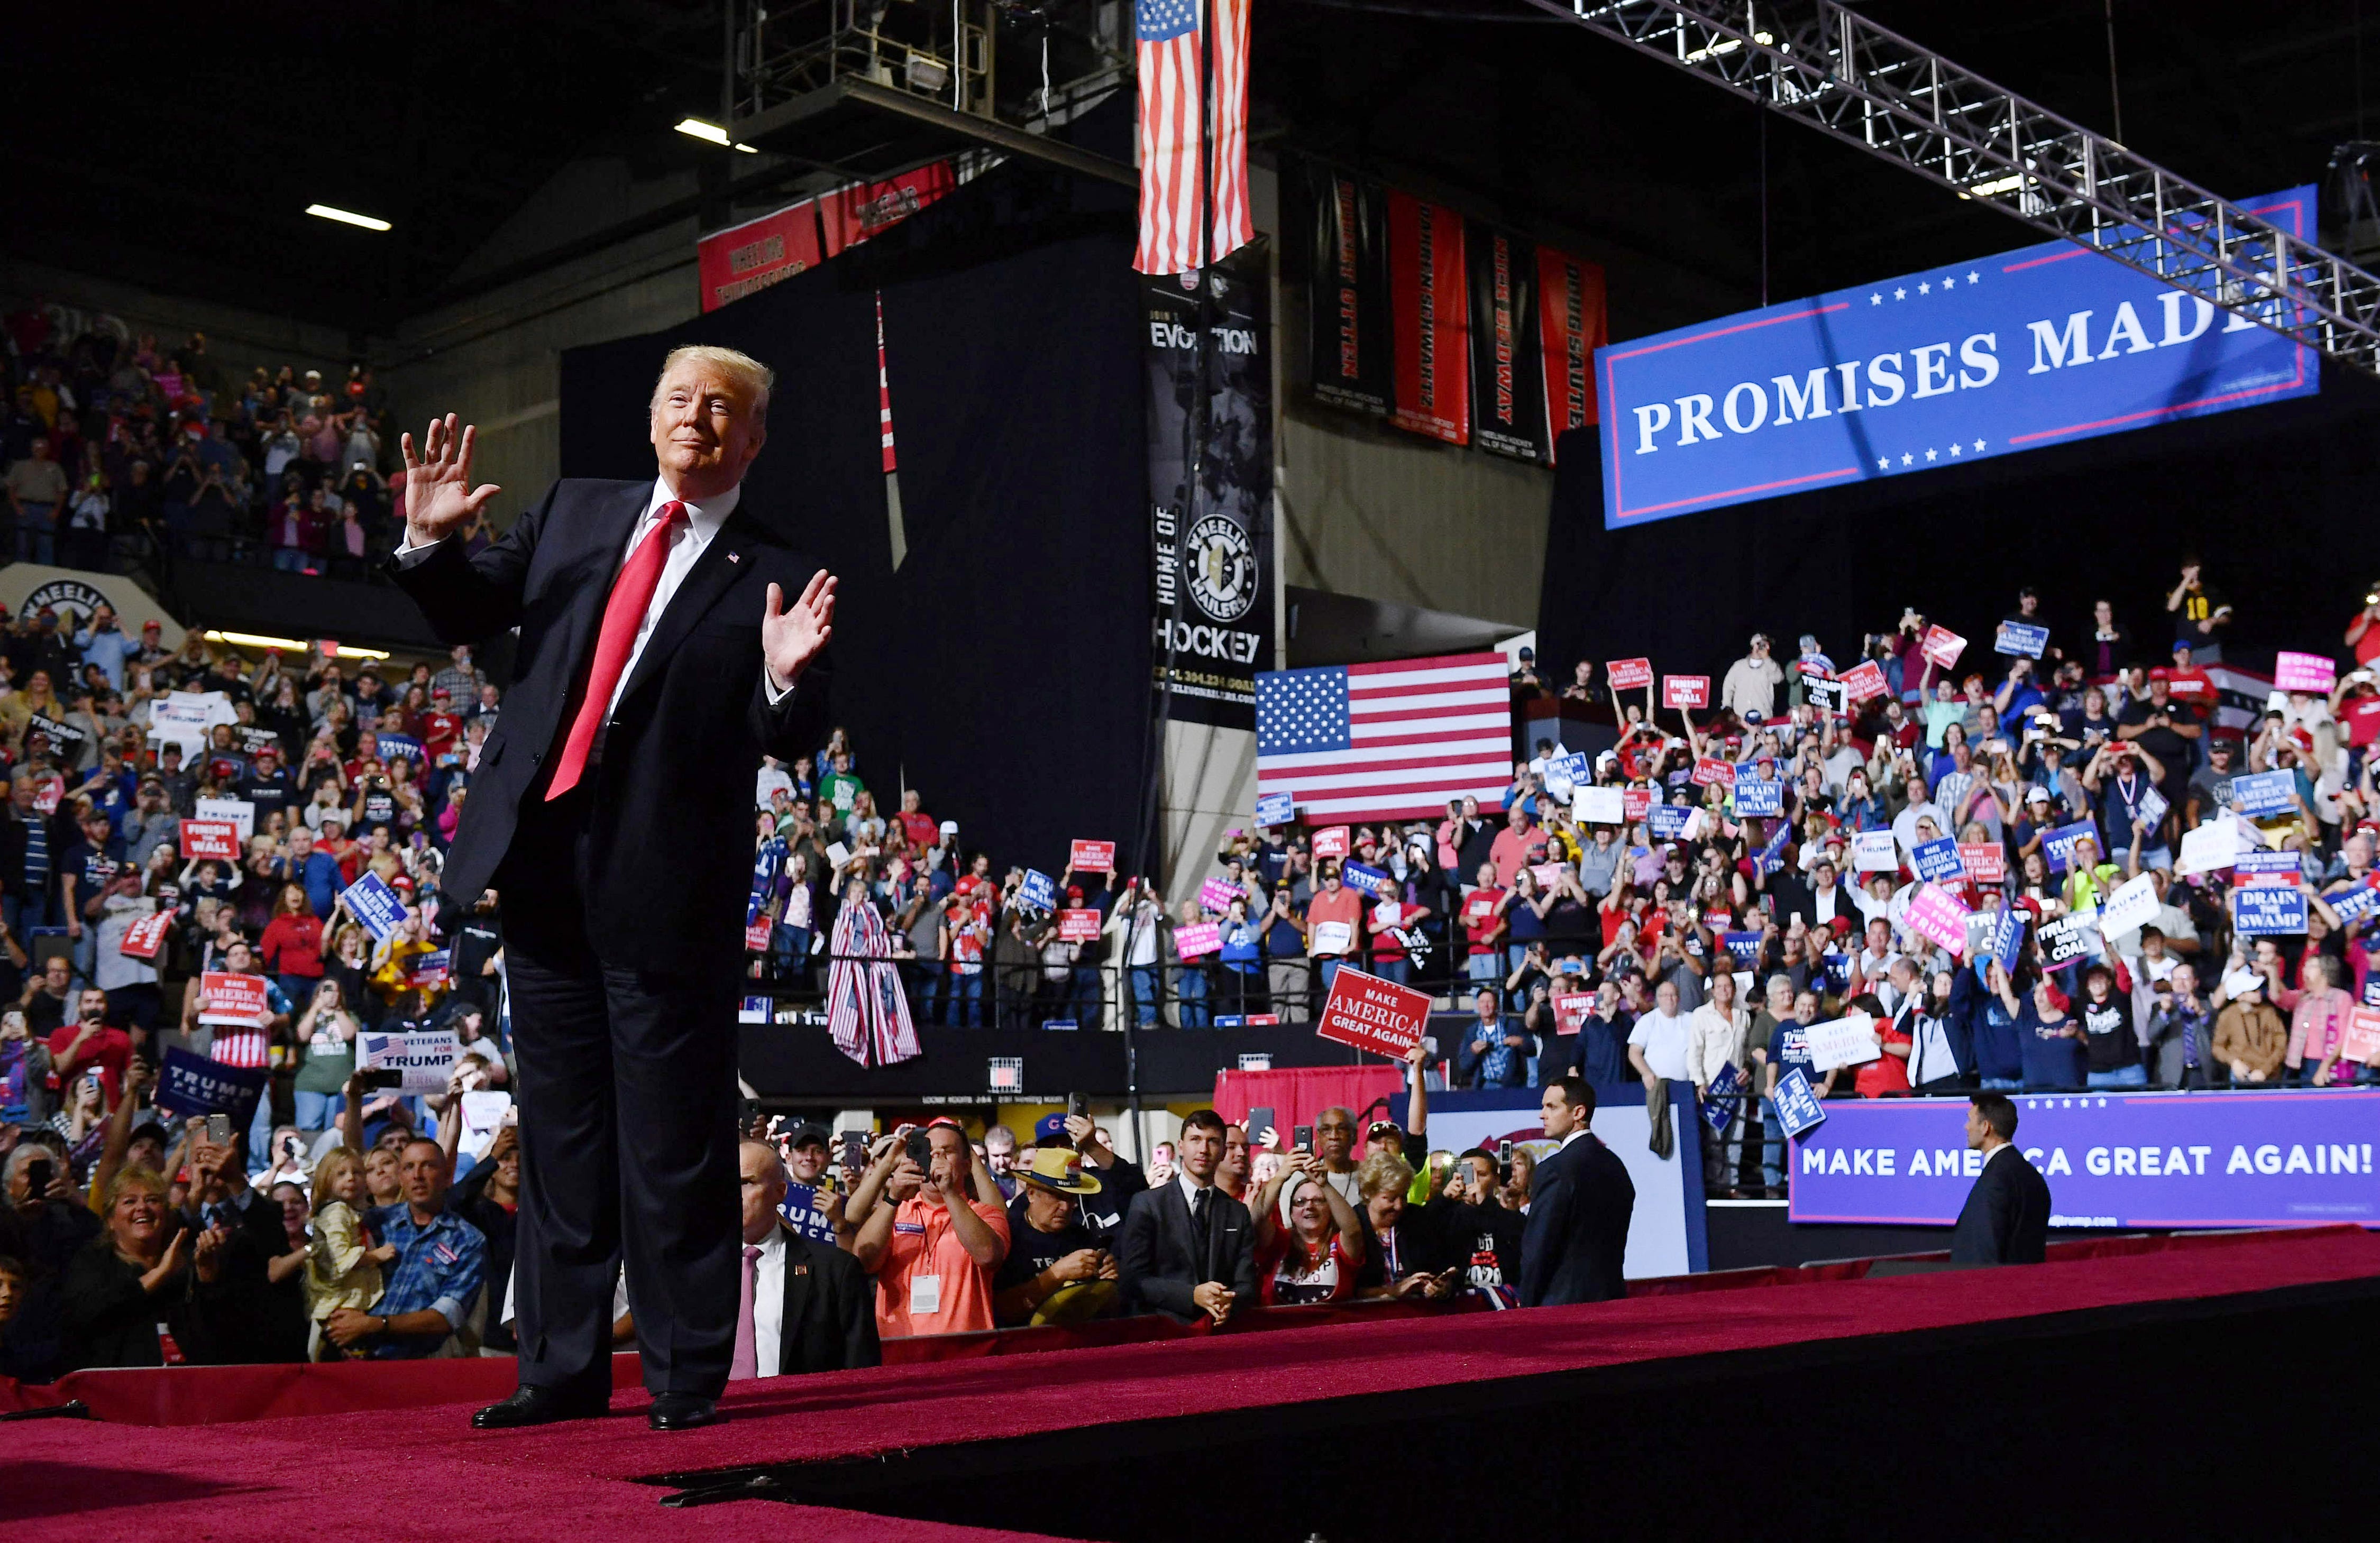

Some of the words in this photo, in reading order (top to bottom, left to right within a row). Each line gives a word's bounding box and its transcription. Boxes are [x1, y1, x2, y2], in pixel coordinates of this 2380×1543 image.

[1151, 322, 1258, 354] EVOTION
[1567, 335, 1585, 430] SAUTE
[1633, 331, 2000, 455] PROMISES
[1157, 506, 1175, 536] OF
[1188, 519, 1255, 571] WHEELING
[1157, 542, 1175, 605] HOME
[25, 584, 104, 619] WHEELI
[1191, 580, 1248, 617] MAILERS
[1158, 619, 1260, 664] HOCKEY
[2280, 655, 2335, 669] WOMEN
[1670, 679, 1703, 688] FINISH
[1802, 675, 1841, 692] TRUMP
[2280, 676, 2331, 687] TRUMP
[1671, 693, 1701, 704] WALL
[1809, 694, 1832, 708] COAL
[32, 715, 83, 740] TRUMP
[243, 742, 258, 754] CO
[1548, 757, 1581, 772] DRAIN
[1739, 786, 1775, 795] DRAIN
[1737, 801, 1778, 811] SWAMP
[1650, 815, 1685, 824] AMERIC
[188, 823, 231, 835] FINISH
[1314, 830, 1343, 842] FINISH
[190, 841, 230, 853] WALL
[1316, 842, 1342, 854] WALL
[1924, 844, 1940, 855] MAKE
[1917, 850, 1960, 869] AMERICA
[1962, 857, 2000, 866] ERICA
[1347, 867, 1381, 883] TRUM
[1201, 895, 1230, 912] TRUM
[1921, 883, 1969, 920] WOM
[2110, 888, 2147, 912] RUMP
[2242, 892, 2297, 906] DRAIN
[2332, 887, 2377, 912] RUMP
[1932, 908, 1953, 928] FOR
[1965, 910, 2032, 929] TRP
[2038, 911, 2098, 941] TRUMP
[2238, 914, 2302, 927] SWAMP
[1174, 923, 1219, 939] WOMEN
[1908, 909, 1962, 949] TRUMP
[1728, 941, 1760, 950] TRU
[2055, 930, 2078, 946] DIGS
[1181, 940, 1222, 957] TRUMP
[2052, 939, 2088, 961] COAL
[206, 987, 265, 1002] AMERICA
[1364, 988, 1398, 1007] MAKE
[1561, 996, 1595, 1010] FINIS
[1329, 994, 1420, 1036] AMERICA
[1332, 1015, 1372, 1035] GREAT
[1371, 1027, 1413, 1049] AGAIN
[1829, 1026, 1850, 1036] KEEP
[404, 1037, 453, 1046] VETERANS
[1815, 1033, 1872, 1054] AMERICA
[384, 1054, 453, 1067] TRUMP
[1833, 1049, 1860, 1060] GREAT
[170, 1065, 253, 1098] TRUMP
[402, 1074, 446, 1084] ERICA
[173, 1081, 242, 1106] PENCE
[1789, 1076, 1818, 1118] DRAIN
[1774, 1086, 1800, 1128] SWAMP
[1802, 1147, 1896, 1177] MAKE
[1908, 1146, 2072, 1177] AMECA
[2085, 1145, 2212, 1177] GREAT
[2226, 1143, 2373, 1175] AGAIN!
[776, 1204, 835, 1231] RUM
[792, 1222, 835, 1243] NCE
[1466, 1265, 1502, 1287] 020
